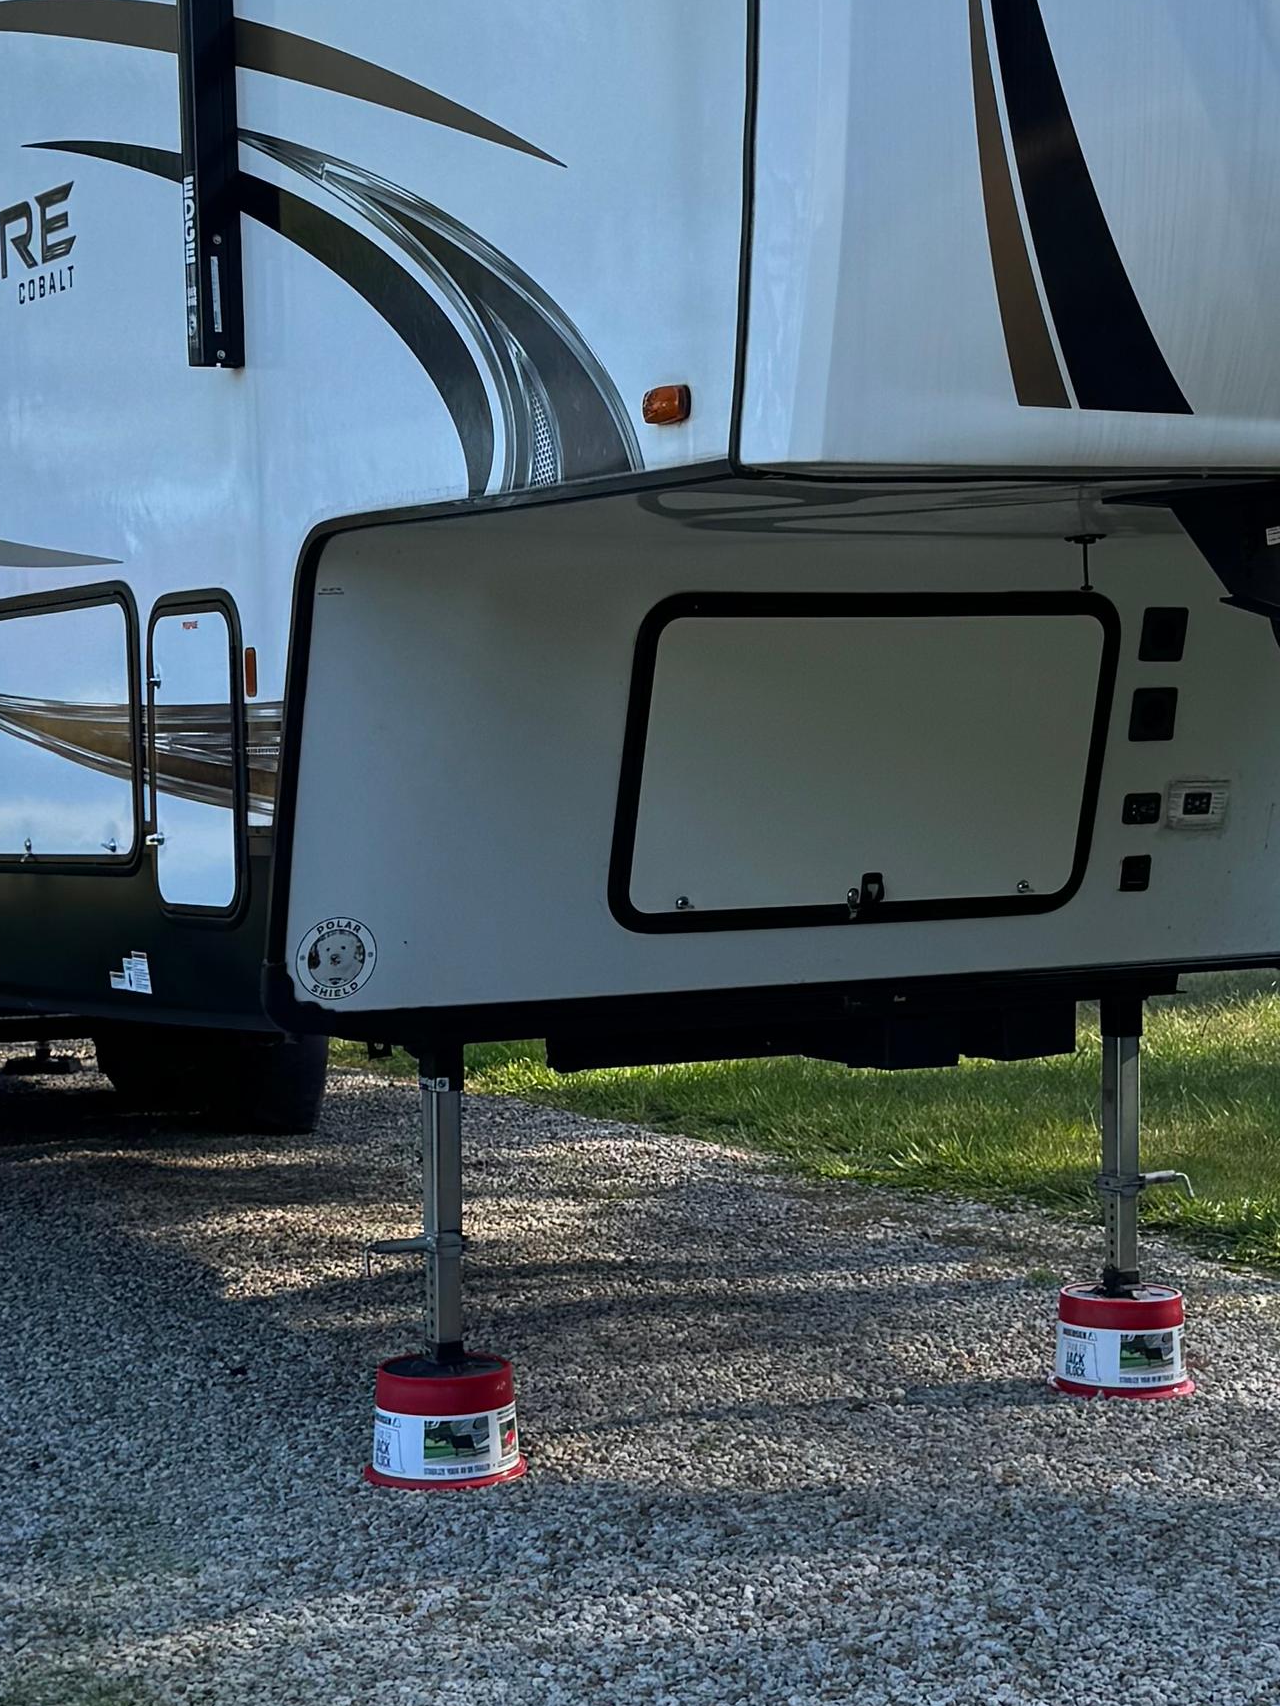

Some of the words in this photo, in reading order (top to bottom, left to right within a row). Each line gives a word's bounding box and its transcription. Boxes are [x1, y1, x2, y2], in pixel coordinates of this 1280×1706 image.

[183, 175, 196, 264] EDGE
[18, 265, 75, 305] COBALT
[316, 919, 362, 935] POLAR
[311, 981, 359, 998] SHIELD
